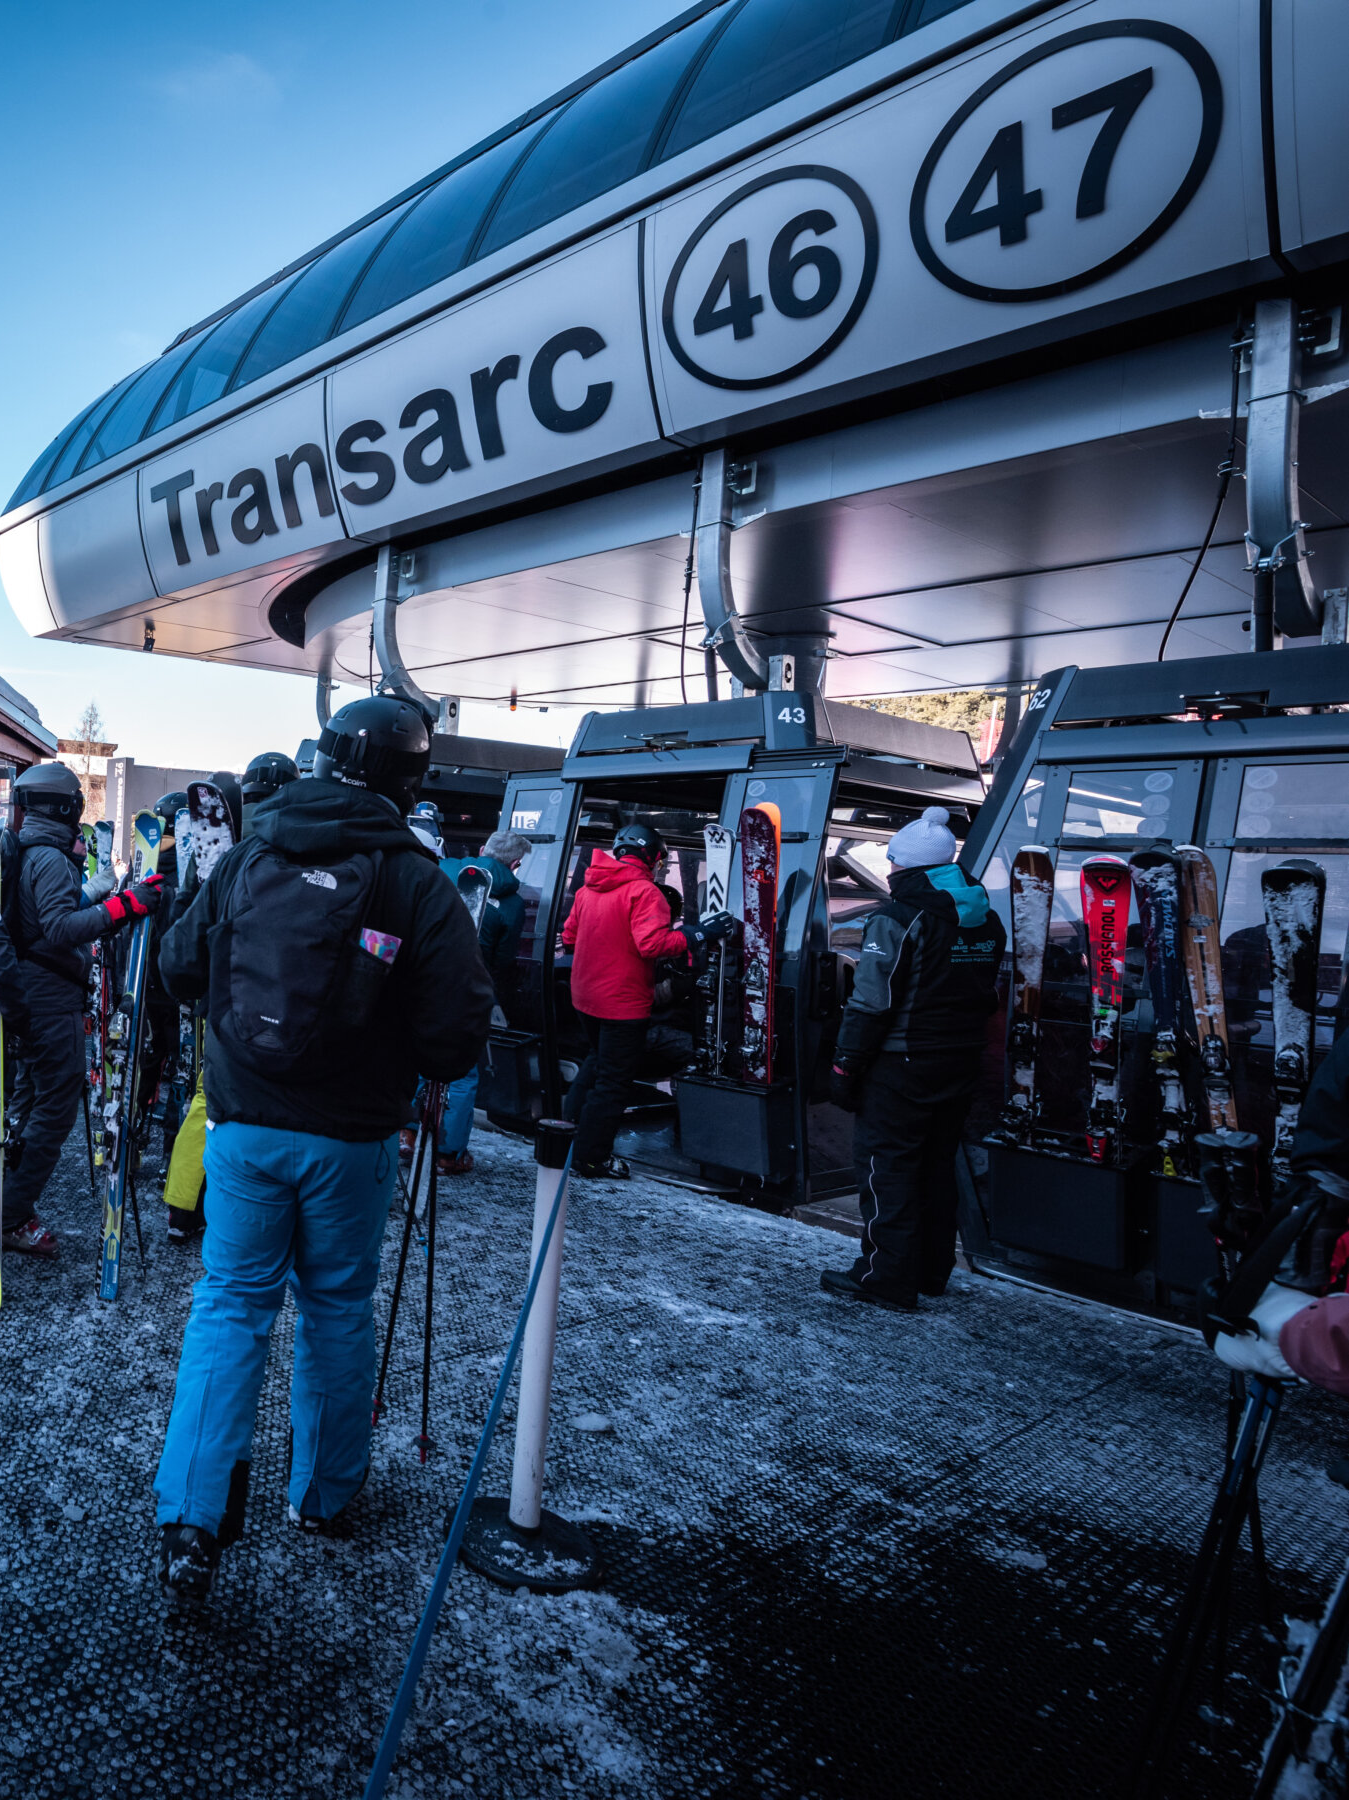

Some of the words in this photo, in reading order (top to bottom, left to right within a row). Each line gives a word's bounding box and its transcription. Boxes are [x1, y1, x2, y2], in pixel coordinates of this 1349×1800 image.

[945, 67, 1155, 247] 47
[693, 208, 843, 341] 46
[149, 325, 615, 565] Transarc
[777, 707, 806, 724] 43
[1028, 688, 1052, 711] 62
[1101, 908, 1116, 974] ROSSIGNOL
